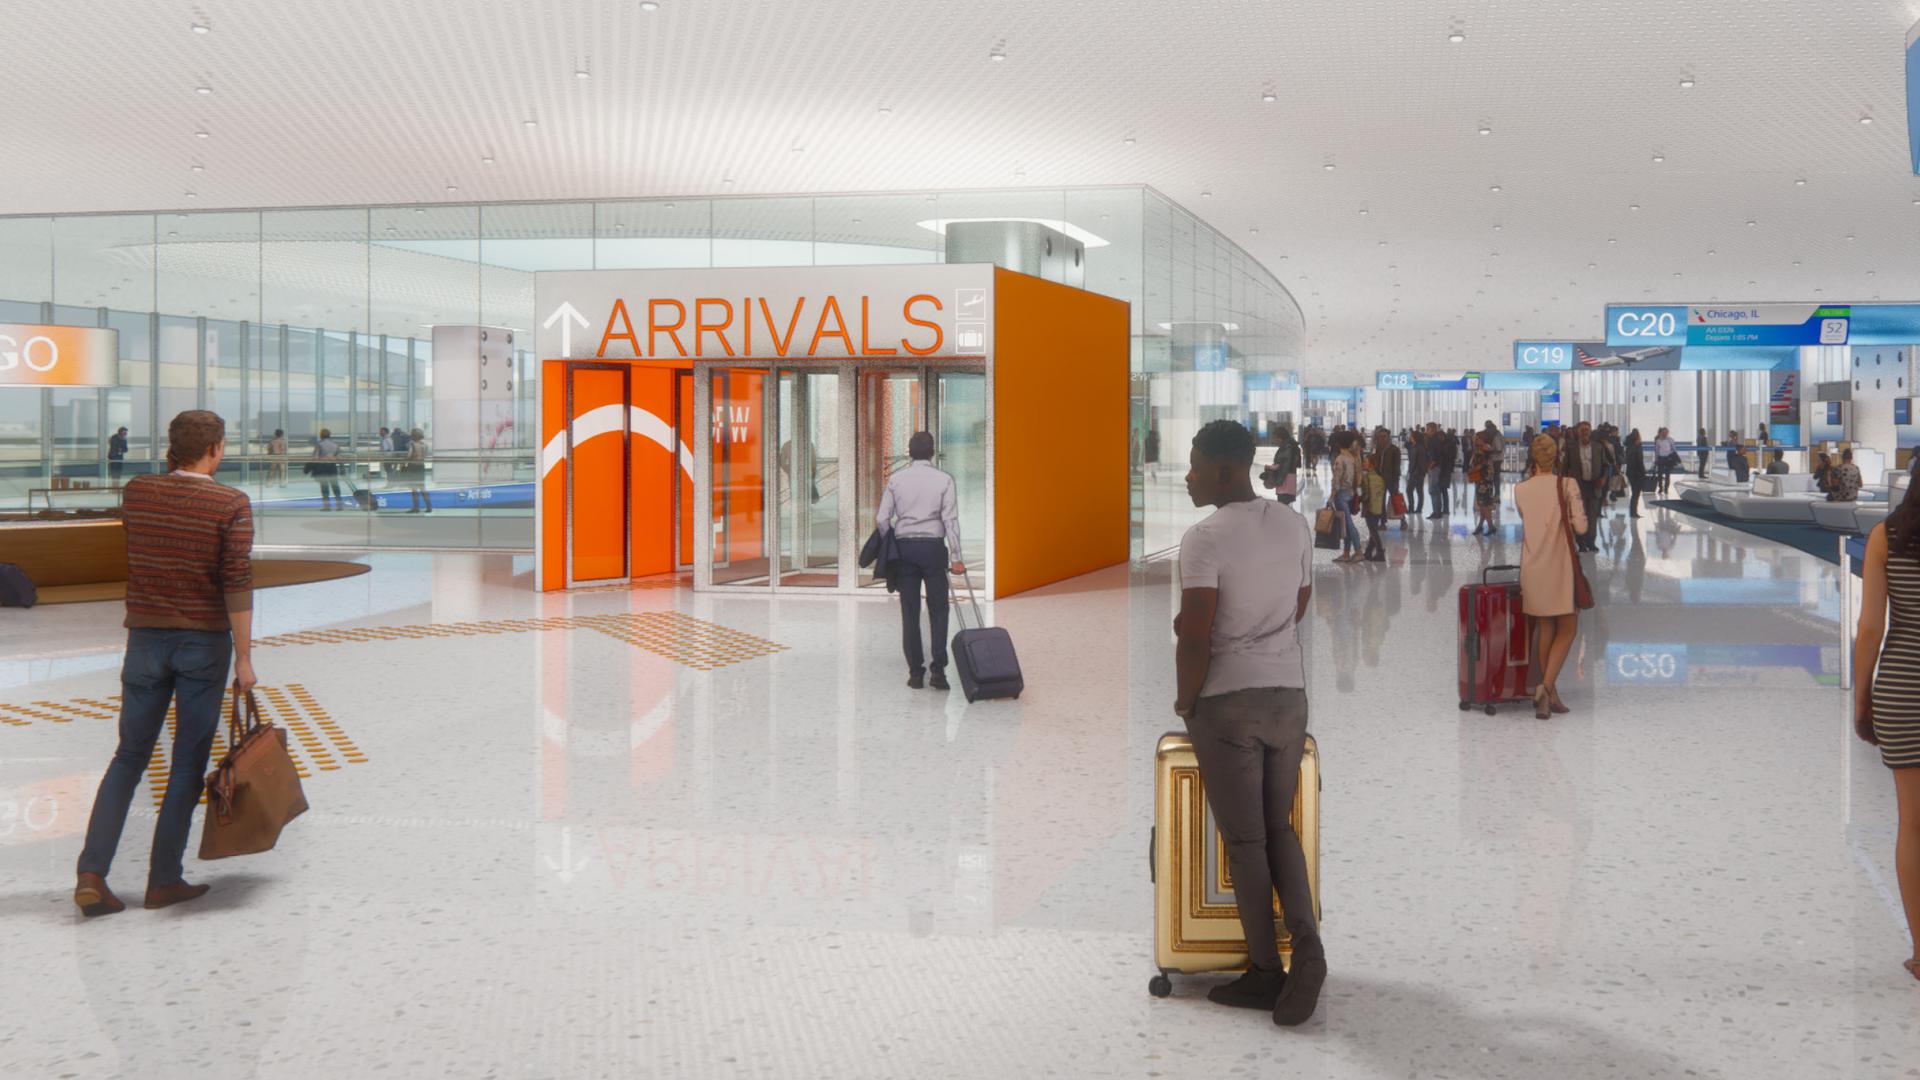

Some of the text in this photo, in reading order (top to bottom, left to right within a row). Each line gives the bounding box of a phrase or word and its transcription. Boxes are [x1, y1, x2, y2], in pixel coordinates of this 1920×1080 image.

[1707, 309, 1760, 320] Chicago, IL
[596, 294, 944, 357] ARRIVALS
[1617, 312, 1676, 337] C20
[1826, 322, 1842, 334] 52
[1523, 347, 1564, 364] C19
[1382, 374, 1407, 386] C18
[712, 406, 751, 443] FW
